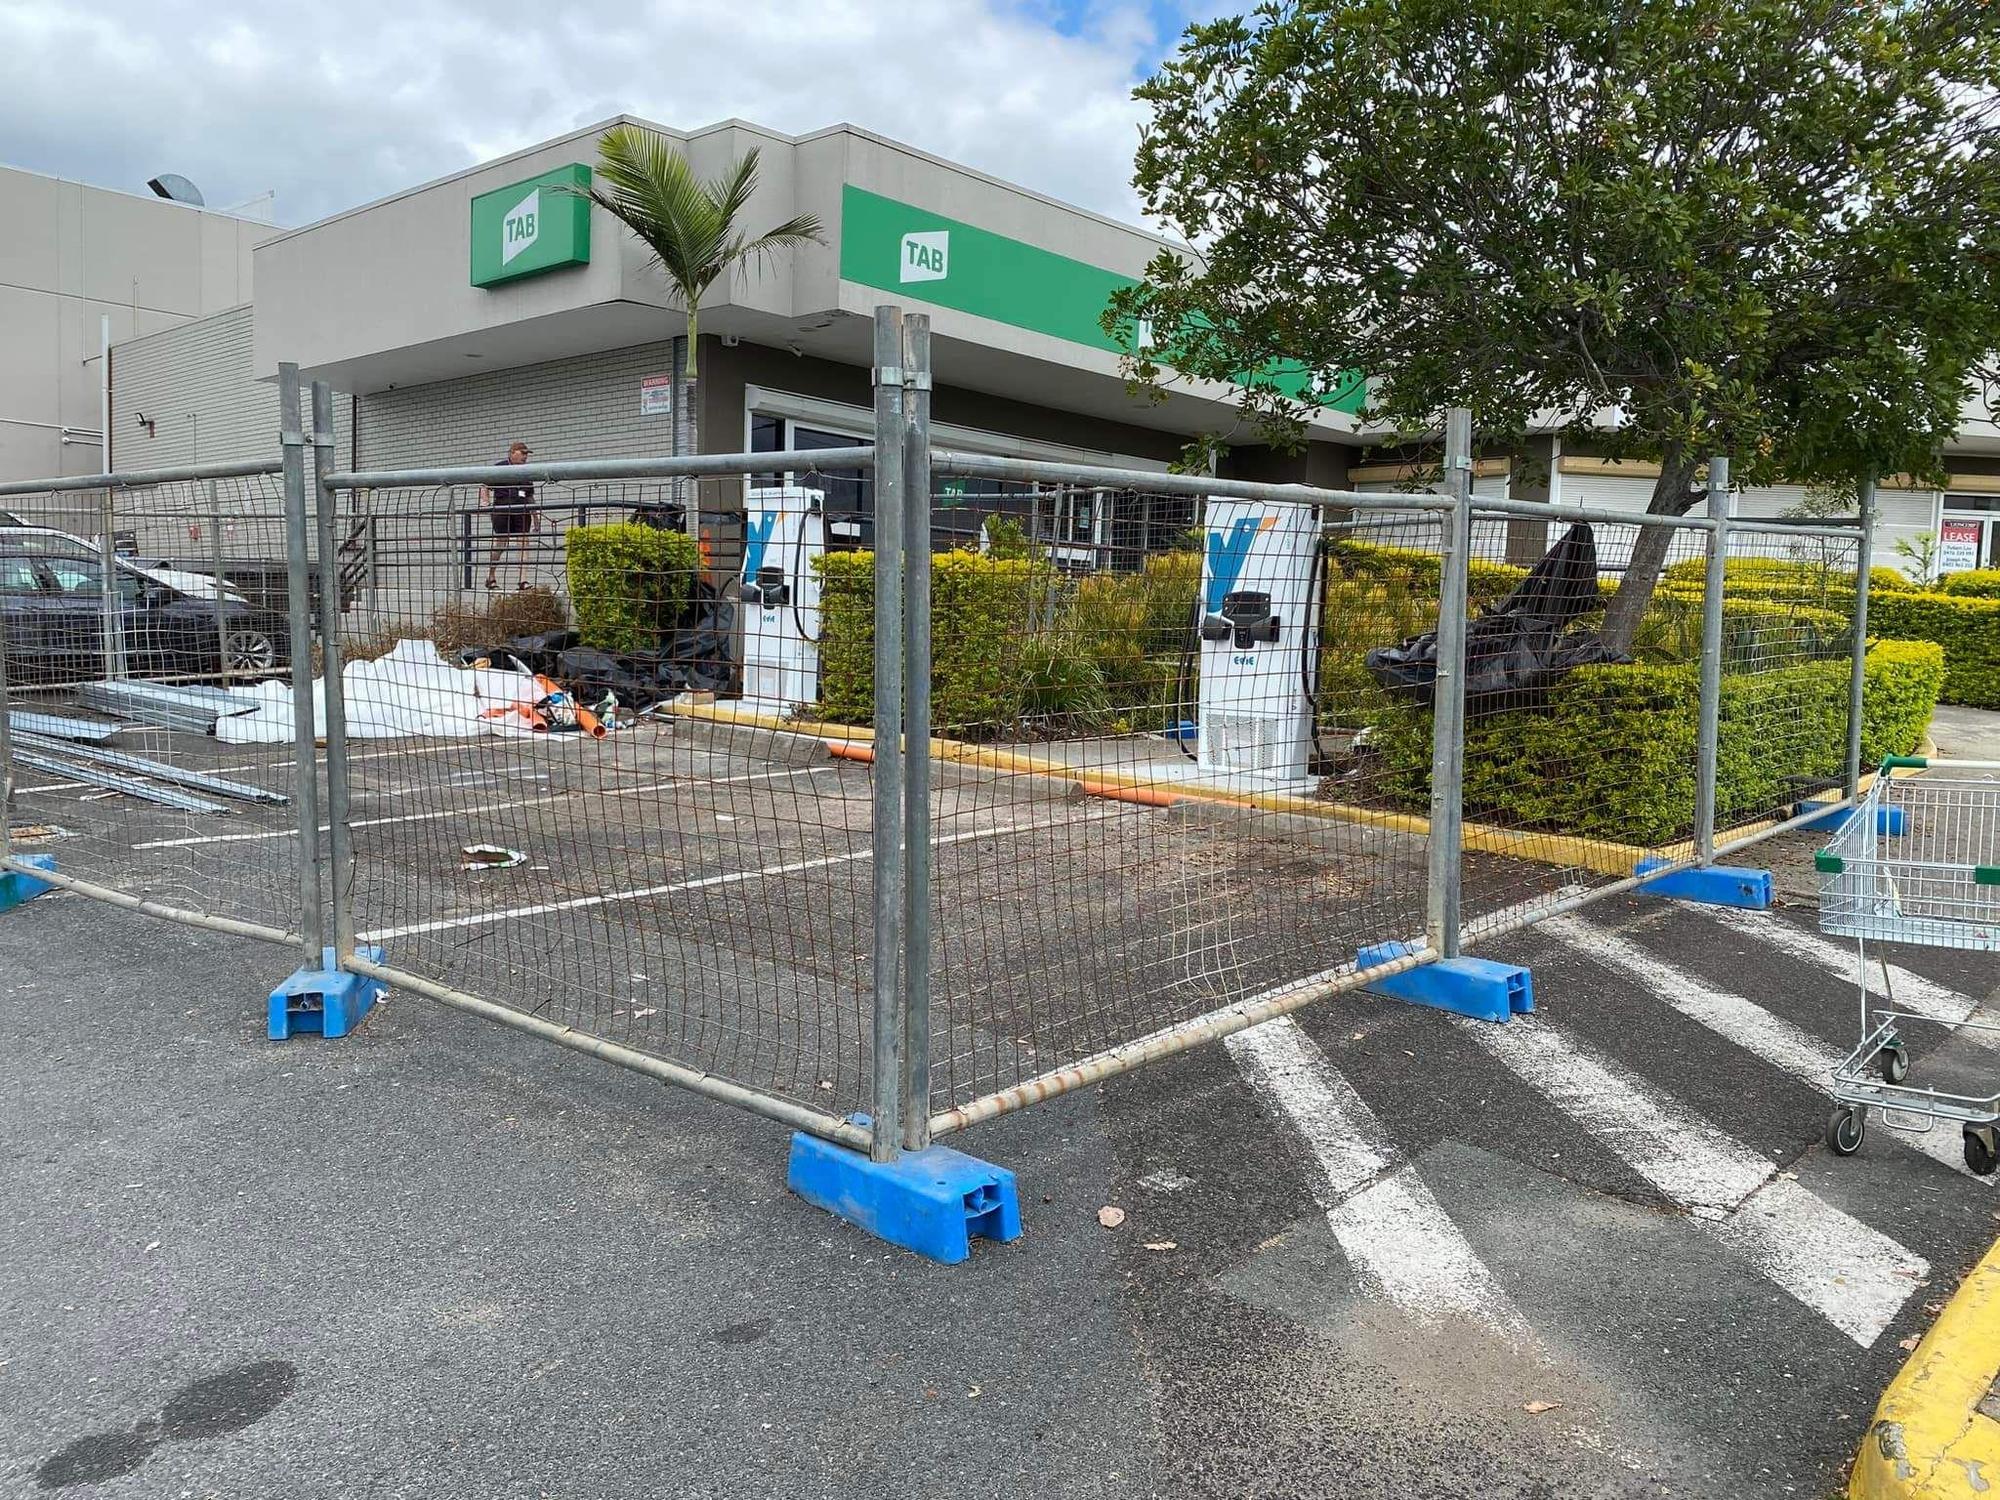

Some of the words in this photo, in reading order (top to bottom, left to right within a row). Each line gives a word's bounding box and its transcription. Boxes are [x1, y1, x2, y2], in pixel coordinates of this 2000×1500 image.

[506, 213, 535, 243] TAB
[906, 240, 943, 273] TAB
[1943, 531, 1976, 542] LEASE
